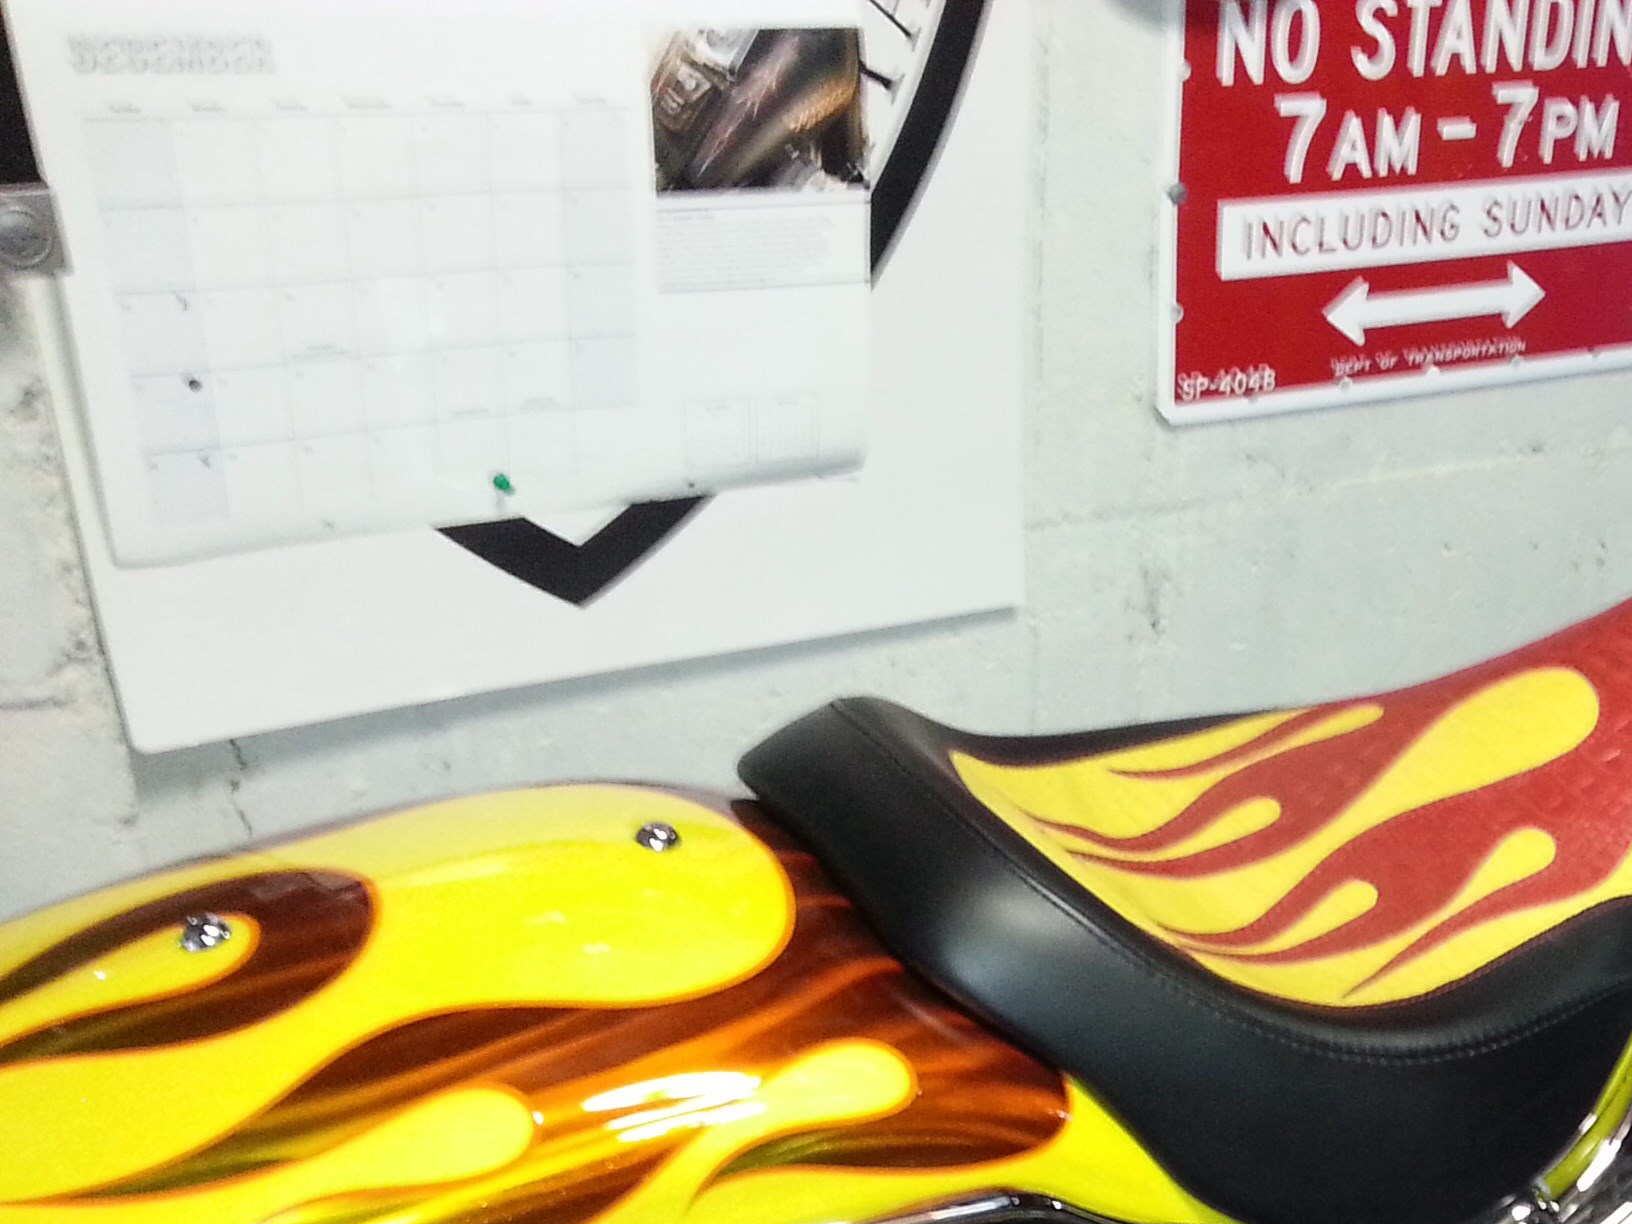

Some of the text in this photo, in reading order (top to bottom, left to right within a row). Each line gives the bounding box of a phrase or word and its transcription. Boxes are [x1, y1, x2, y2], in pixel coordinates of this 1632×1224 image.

[1216, 0, 1320, 86] NO
[1242, 201, 1463, 261] INCLUDING
[1402, 334, 1527, 367] TRANSPORTATION
